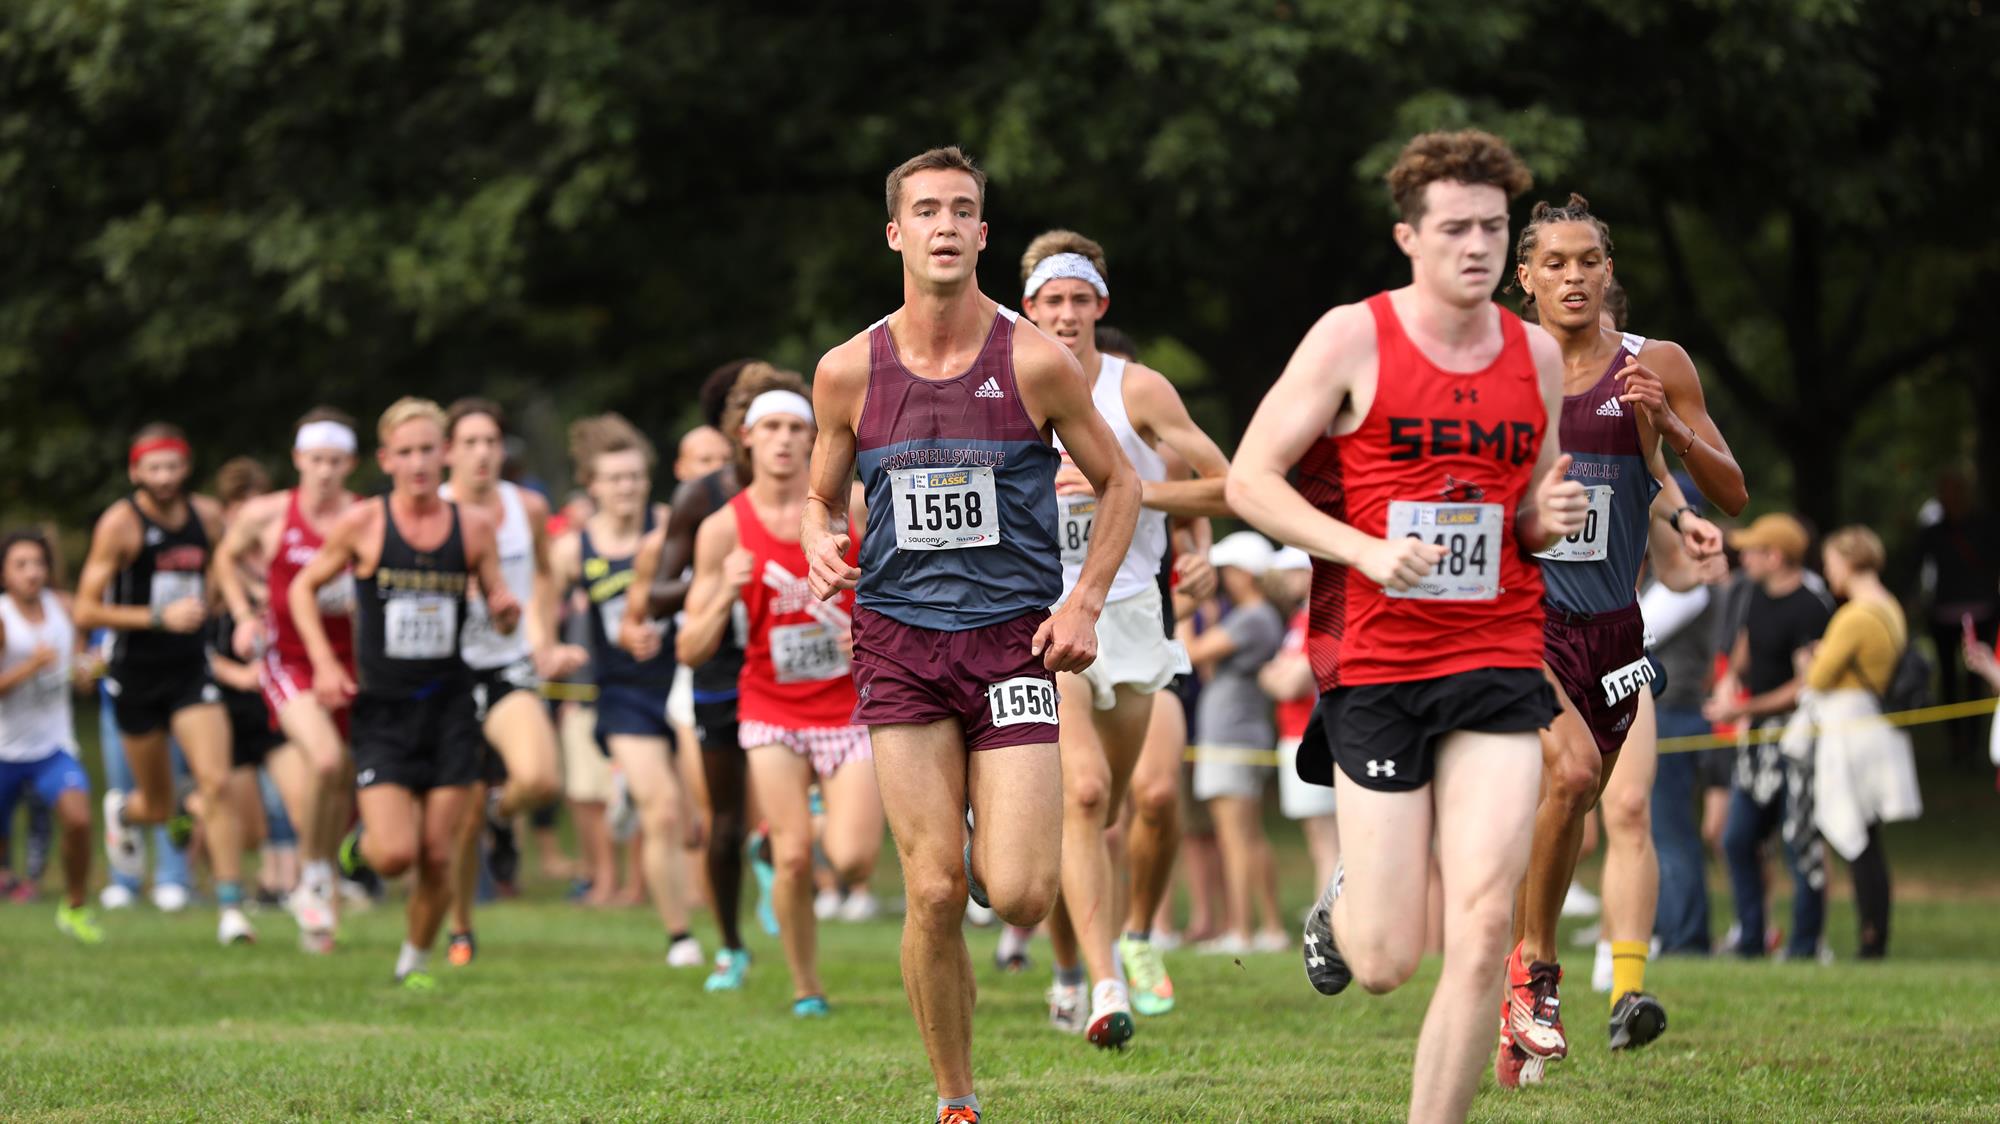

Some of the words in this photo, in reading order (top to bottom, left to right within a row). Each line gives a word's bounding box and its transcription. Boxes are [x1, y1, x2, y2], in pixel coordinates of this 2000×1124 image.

[974, 389, 1004, 398] adidas
[1596, 408, 1623, 417] adidas
[880, 449, 1005, 472] CAMPBELLSVILLE
[930, 476, 968, 487] CLASSIC
[905, 491, 983, 531] 1558
[908, 536, 941, 544] saucony
[1405, 532, 1488, 577] 484
[993, 684, 1054, 720] 1558
